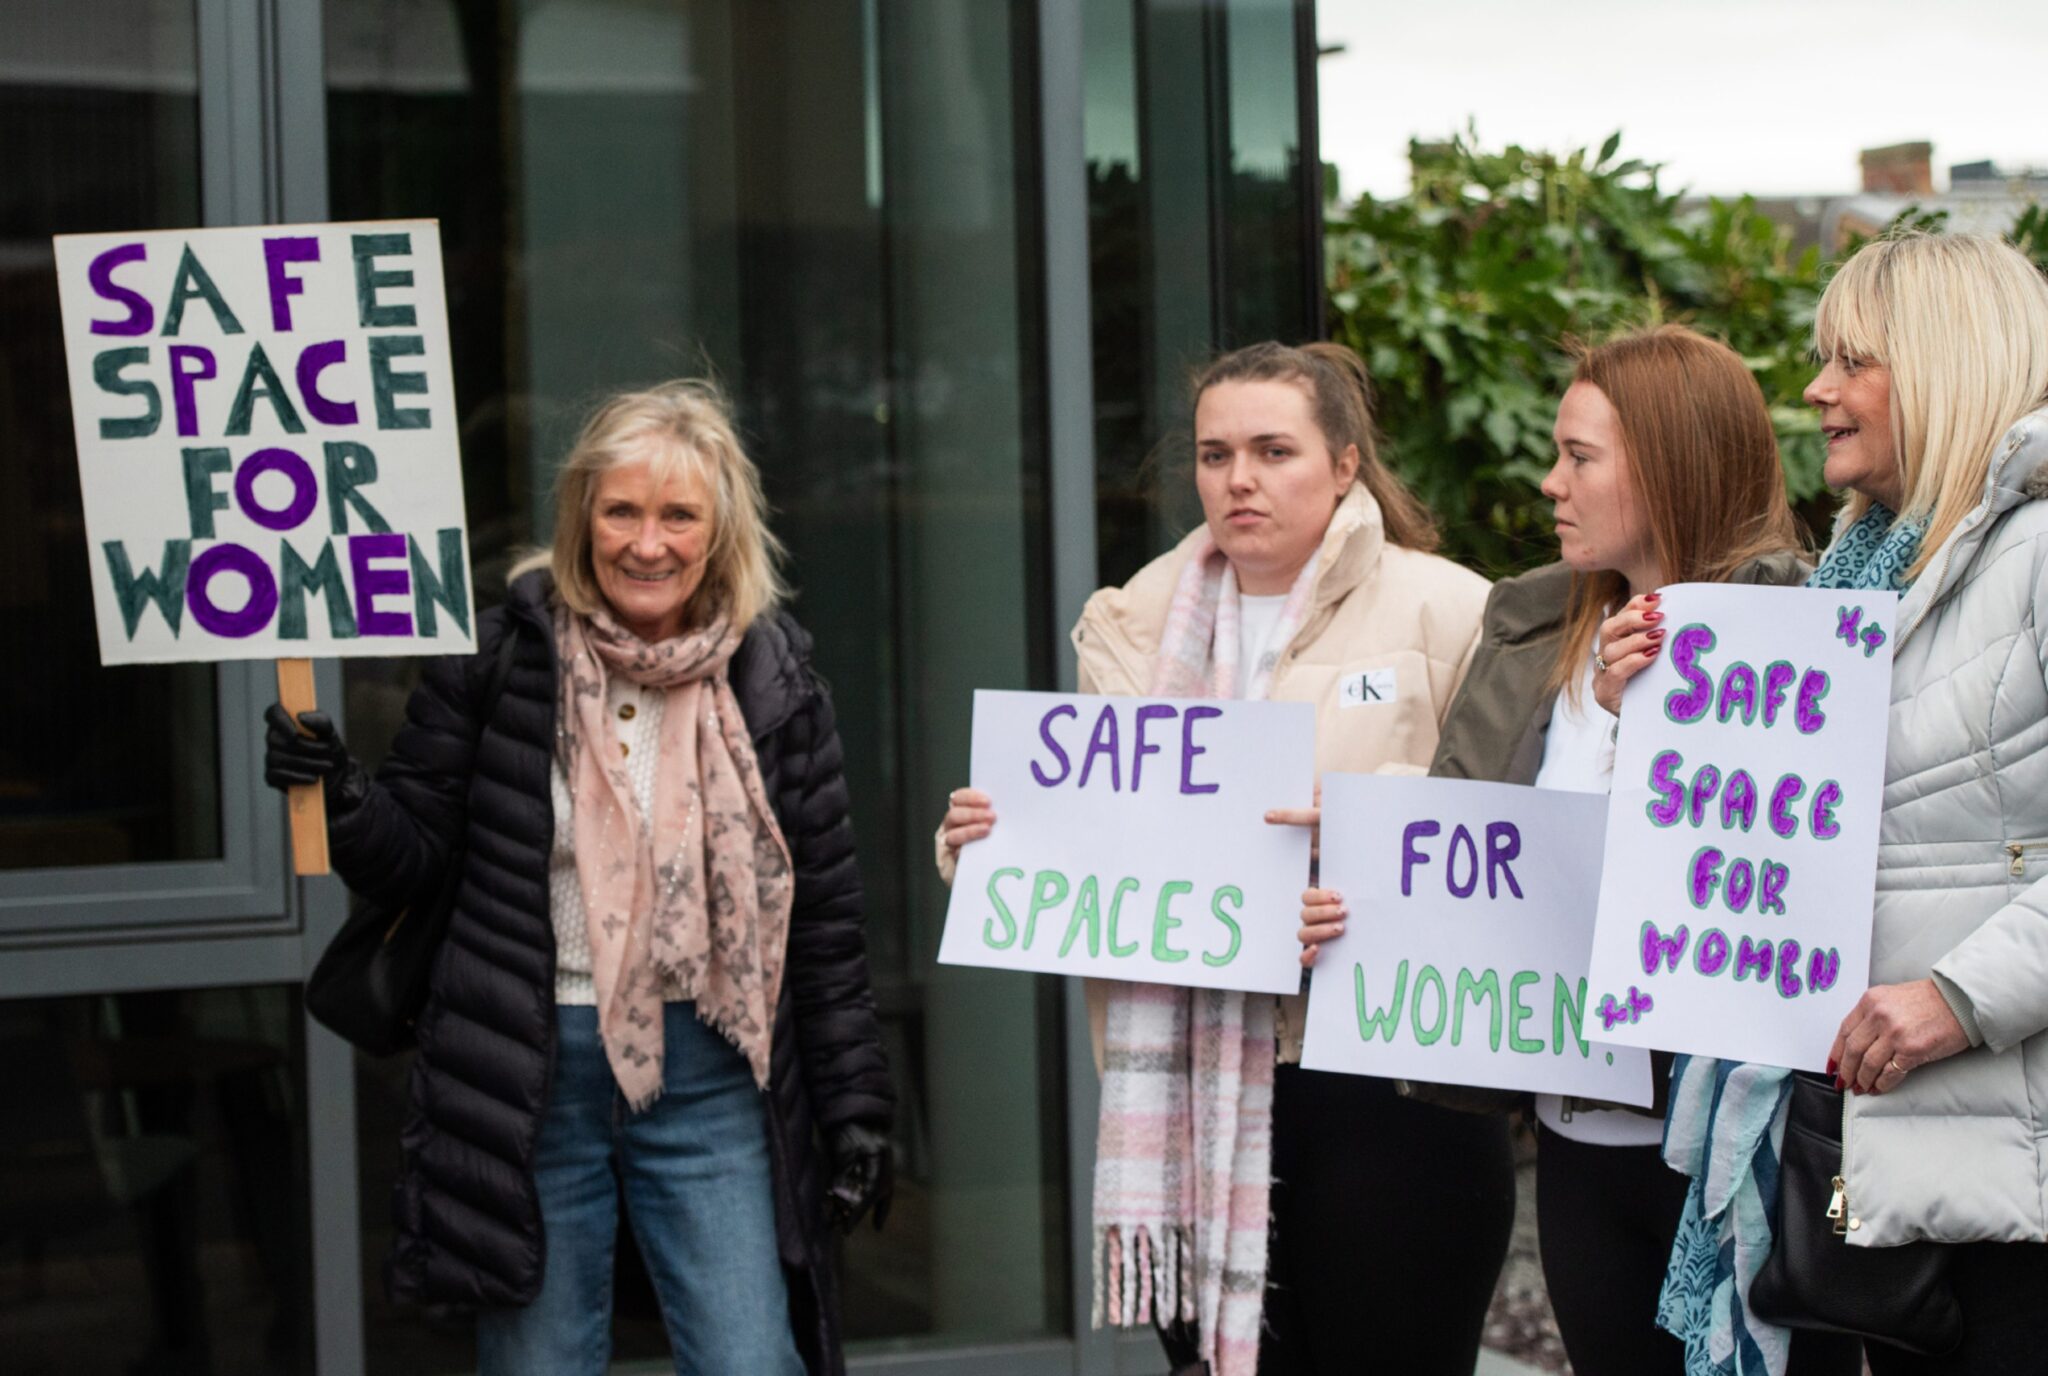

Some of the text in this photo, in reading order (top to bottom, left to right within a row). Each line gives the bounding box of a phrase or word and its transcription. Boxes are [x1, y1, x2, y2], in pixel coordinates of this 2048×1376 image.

[87, 233, 417, 336] SAFE
[92, 334, 432, 439] SPACE
[180, 441, 397, 539] FOR
[102, 527, 471, 642] WOMEN
[1664, 623, 1831, 734] SAFE
[1031, 704, 1223, 794] SAFE
[1646, 750, 1843, 840] SPACE
[1401, 820, 1524, 900] FOR
[1687, 846, 1790, 915] FOR
[983, 867, 1243, 967] SPACES
[1640, 920, 1841, 999] WOMEN
